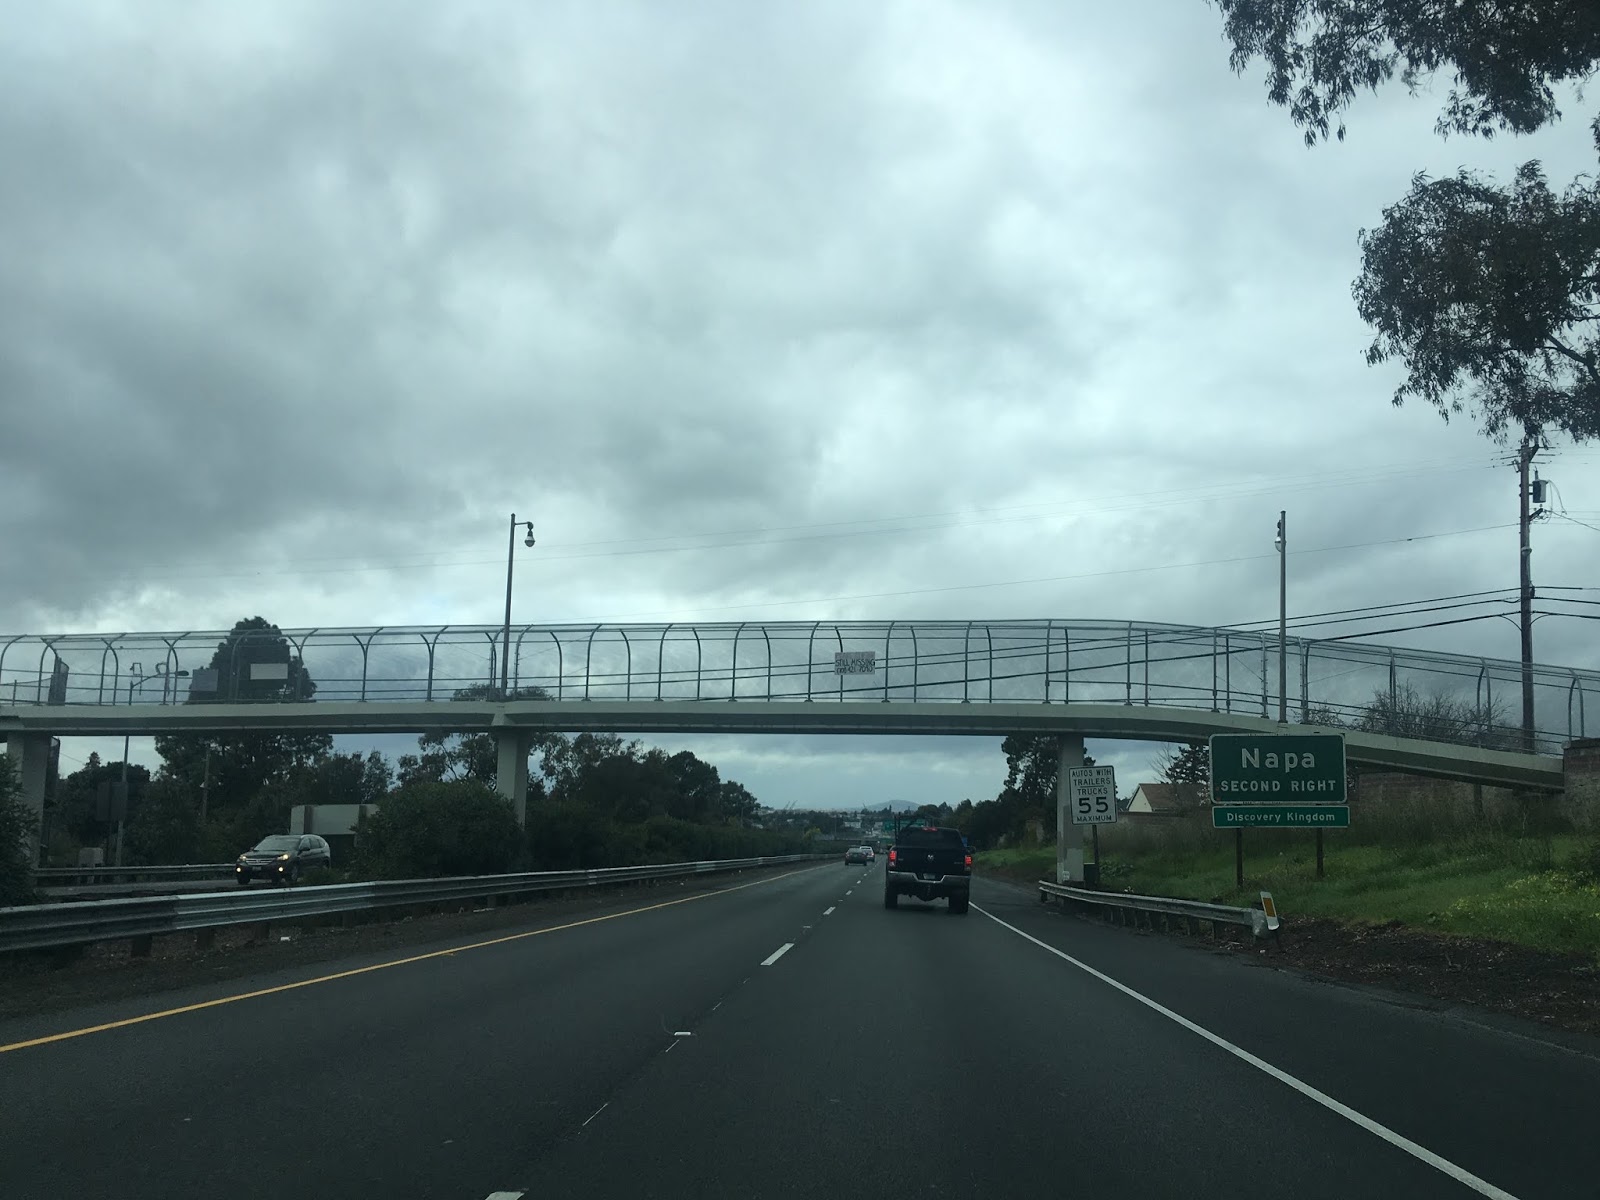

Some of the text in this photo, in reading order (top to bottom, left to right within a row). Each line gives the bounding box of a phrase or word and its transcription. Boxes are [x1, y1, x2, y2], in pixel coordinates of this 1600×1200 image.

[1241, 748, 1315, 773] Napa
[1072, 768, 1111, 777] AUTOS WITH
[1073, 778, 1110, 786] TRAILERS
[1220, 780, 1336, 791] SECOND RIGHT
[1077, 787, 1108, 795] TRUCKS
[1079, 796, 1108, 814] 55
[1226, 812, 1335, 823] Discovery Kingdom
